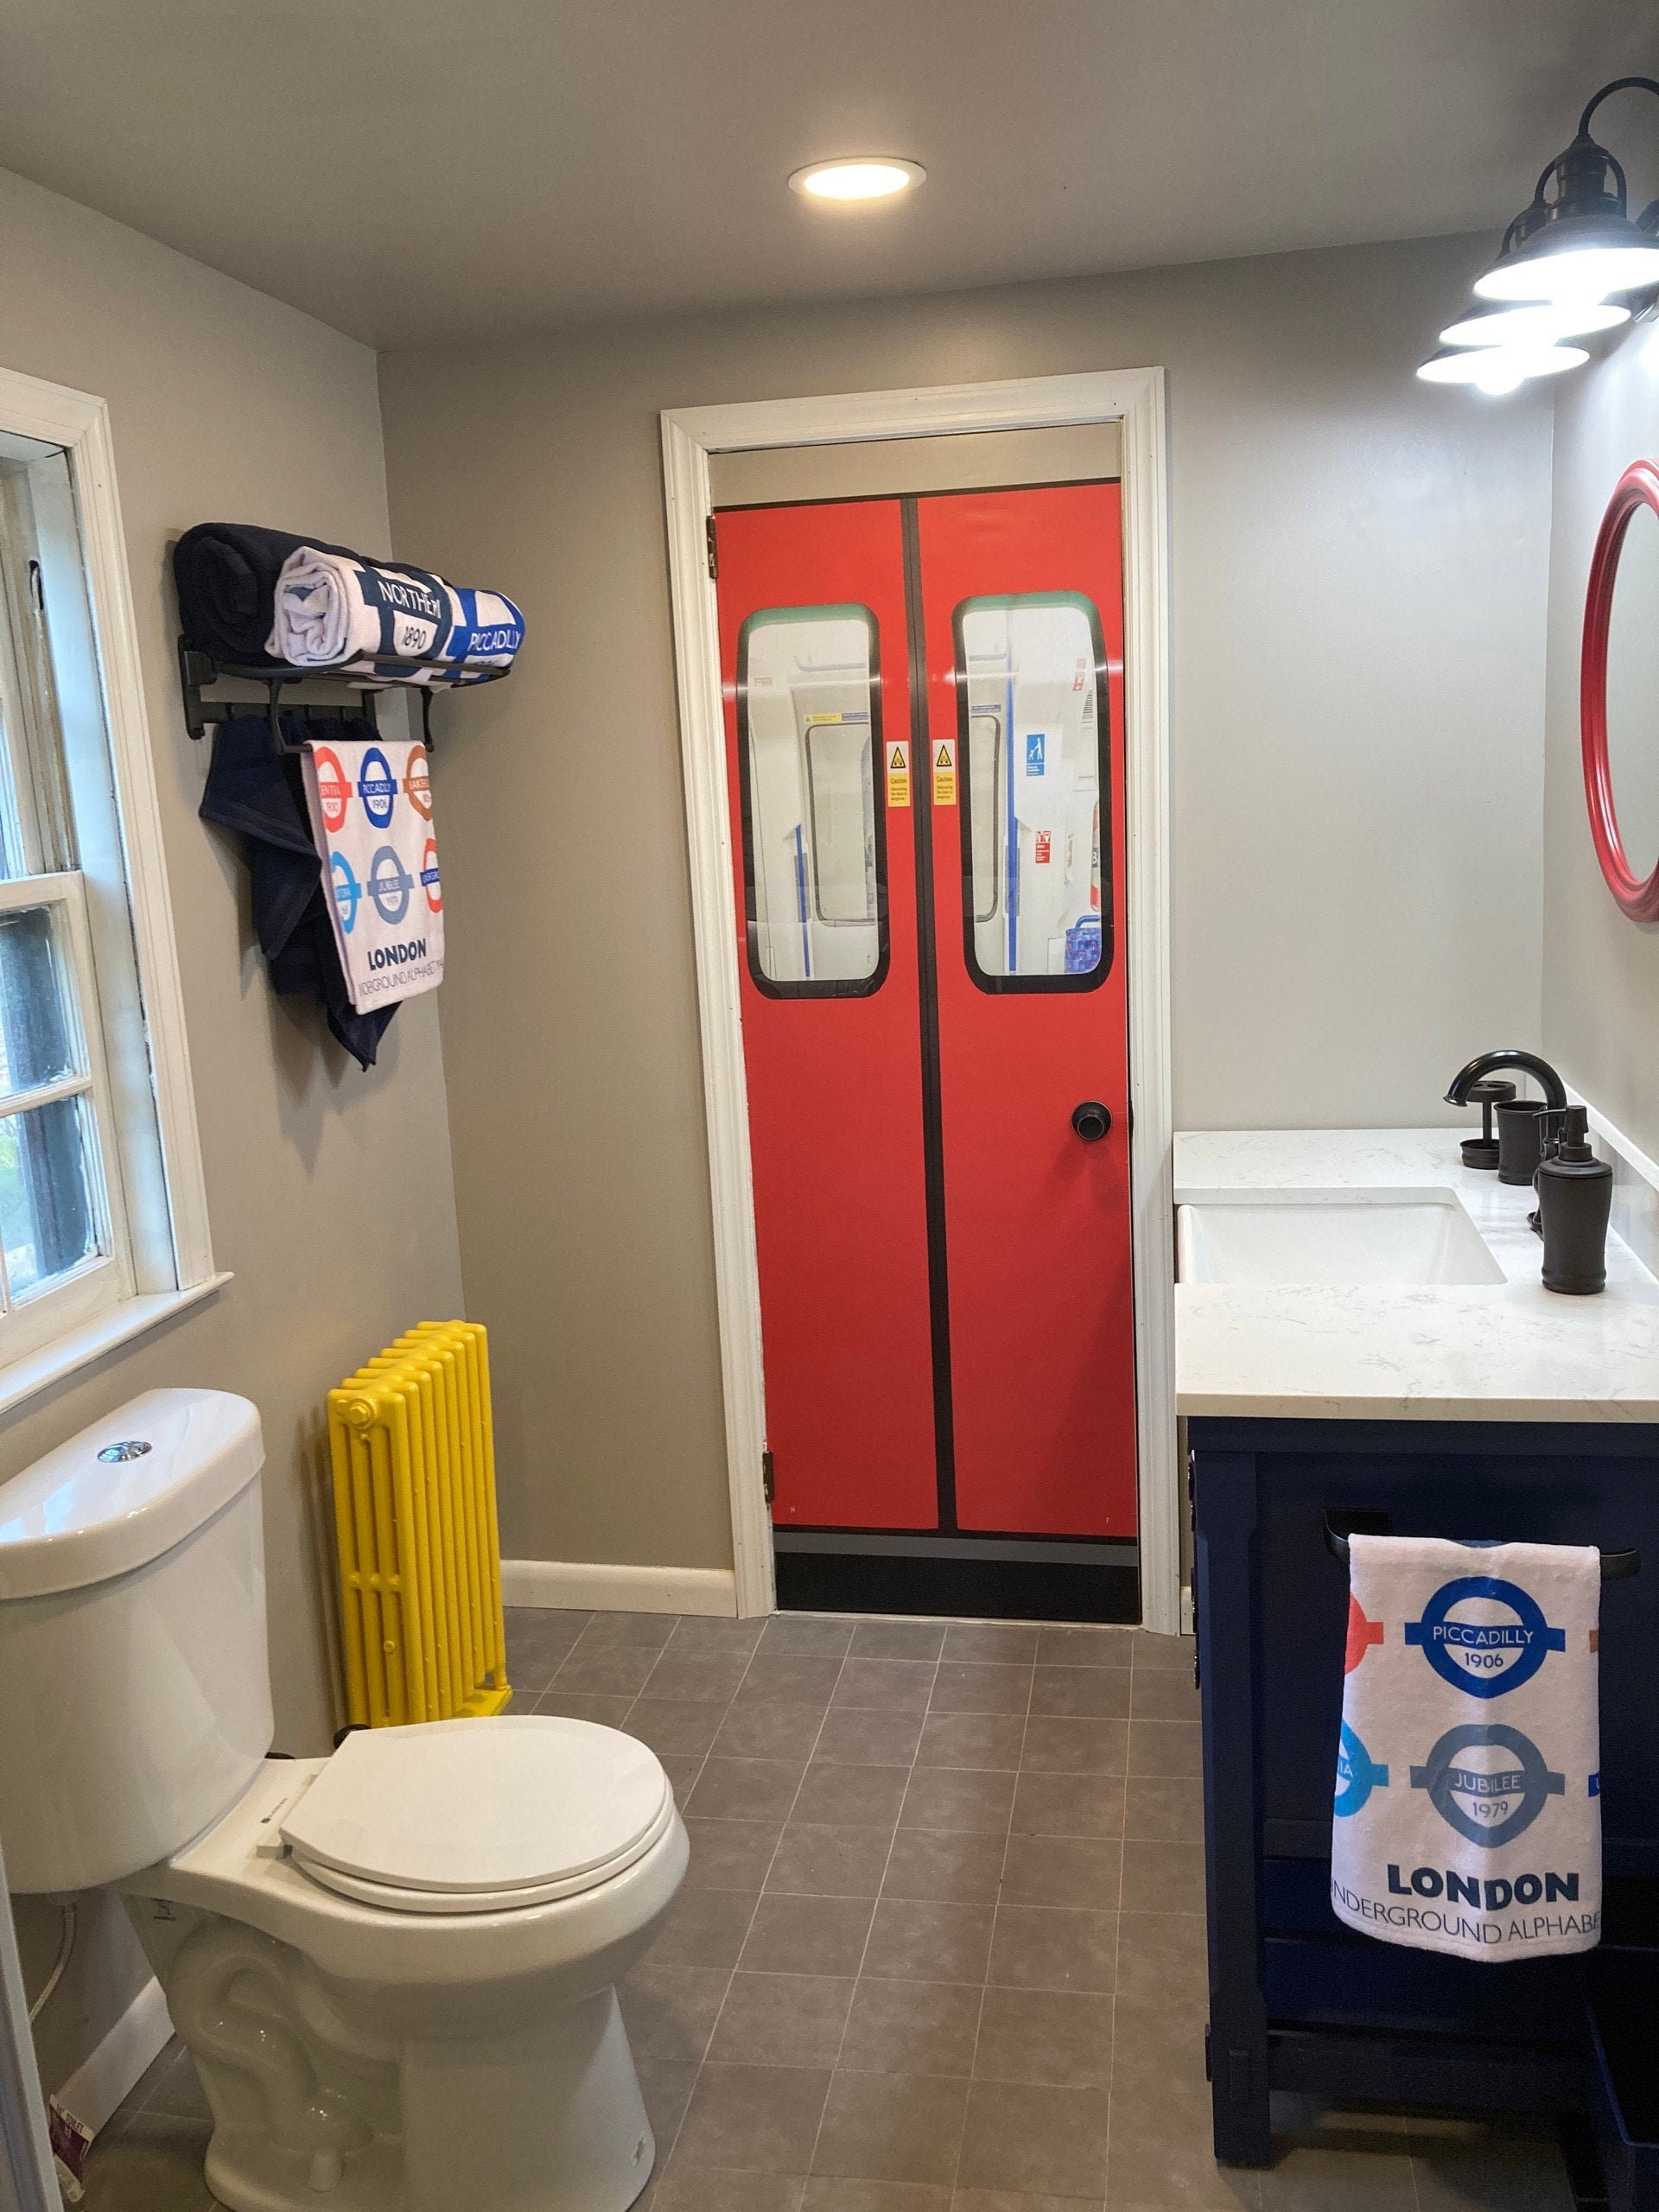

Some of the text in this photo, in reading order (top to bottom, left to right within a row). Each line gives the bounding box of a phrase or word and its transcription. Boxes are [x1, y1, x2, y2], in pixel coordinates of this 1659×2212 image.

[401, 626, 427, 650] 1890
[367, 938, 426, 970] LONDON
[1433, 1626, 1534, 1645] PICCADILLY
[1465, 1652, 1503, 1669] 1906
[1454, 1773, 1521, 1793] JUBILEE
[1472, 1801, 1509, 1819] 1979
[1387, 1864, 1580, 1911] LONDON
[1331, 1878, 1502, 1944] NDERGROUND
